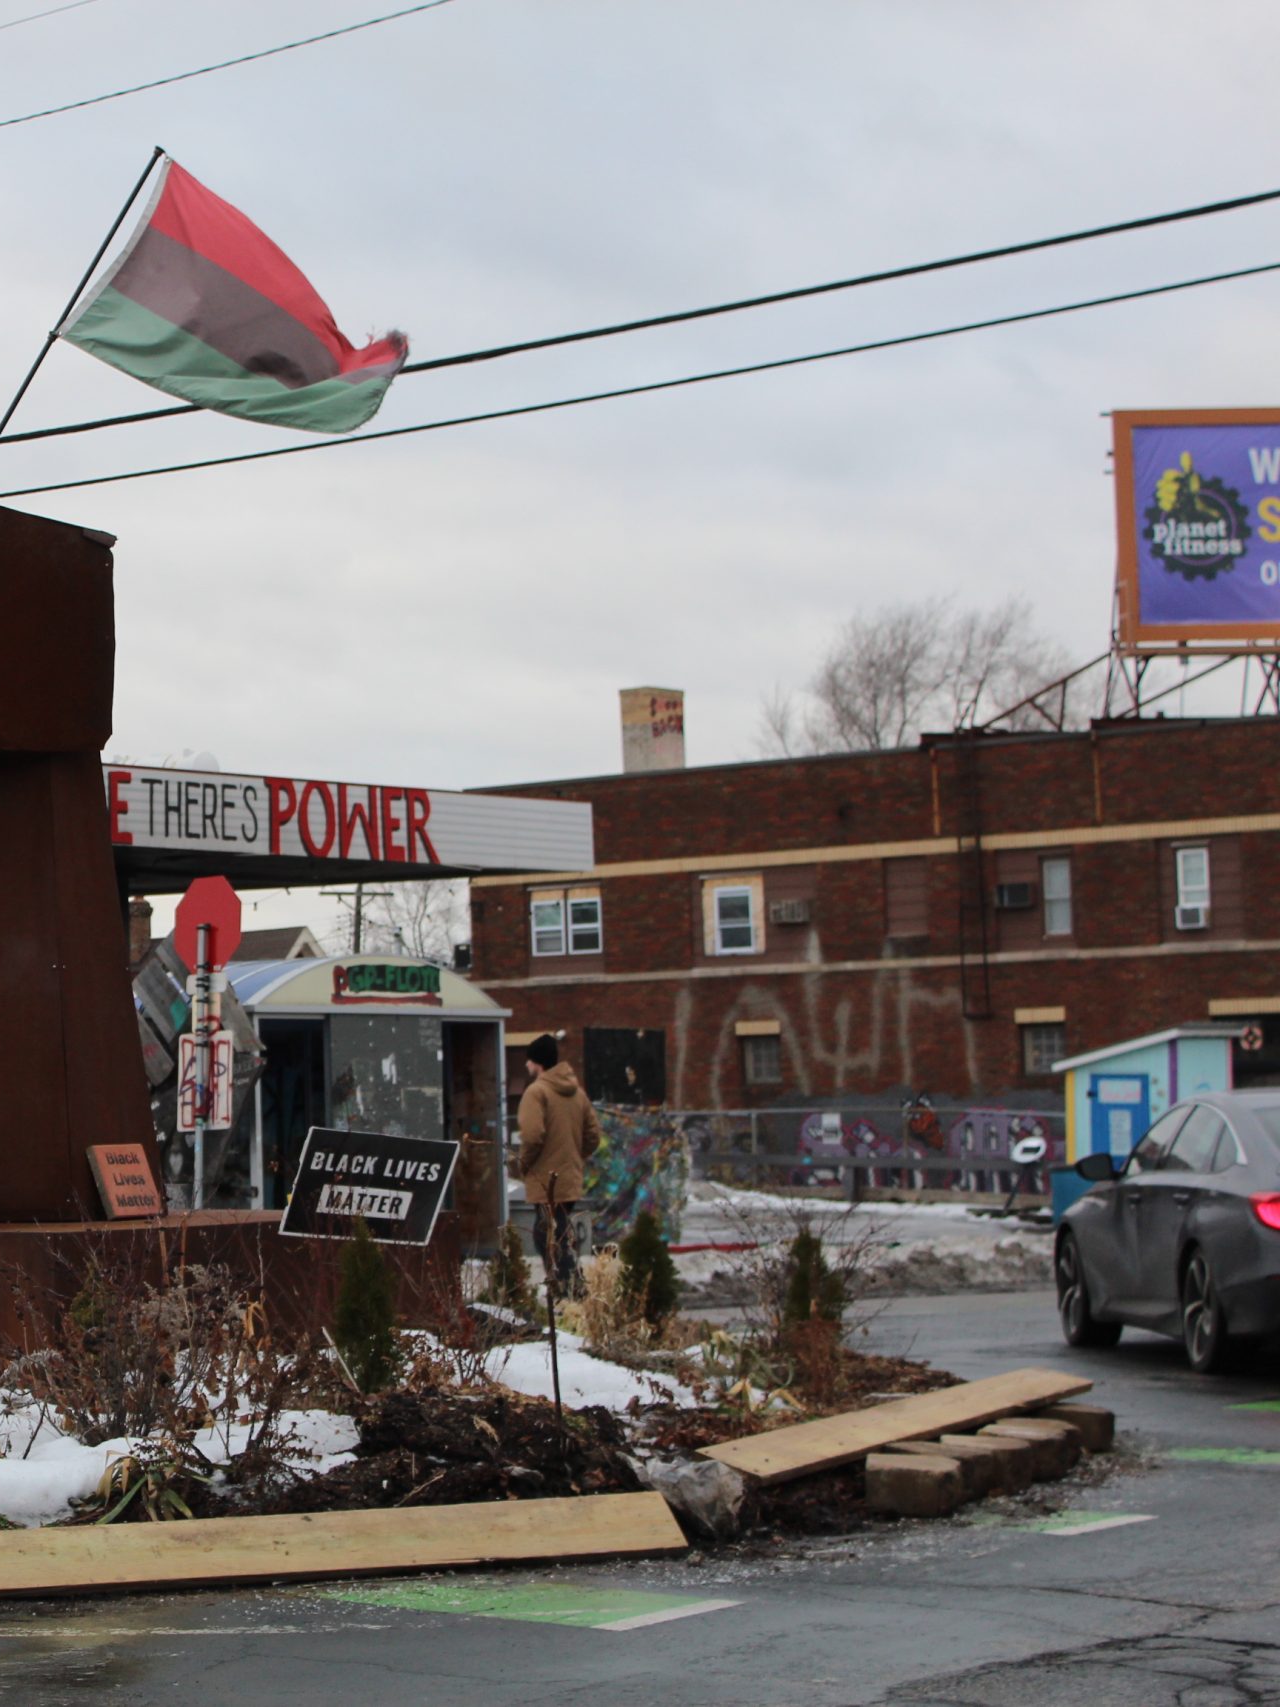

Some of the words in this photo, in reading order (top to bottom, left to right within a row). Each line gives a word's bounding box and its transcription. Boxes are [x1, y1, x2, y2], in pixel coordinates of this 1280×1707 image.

[1153, 519, 1227, 543] planet
[1164, 537, 1244, 555] fitness
[141, 778, 259, 843] THERE'S
[264, 776, 441, 865] POWER
[105, 1152, 140, 1165] Black
[310, 1151, 379, 1176] BLACK
[383, 1158, 441, 1182] LIVES
[113, 1173, 145, 1185] Lives
[115, 1194, 155, 1207] Matter
[325, 1189, 403, 1214] MATTER
